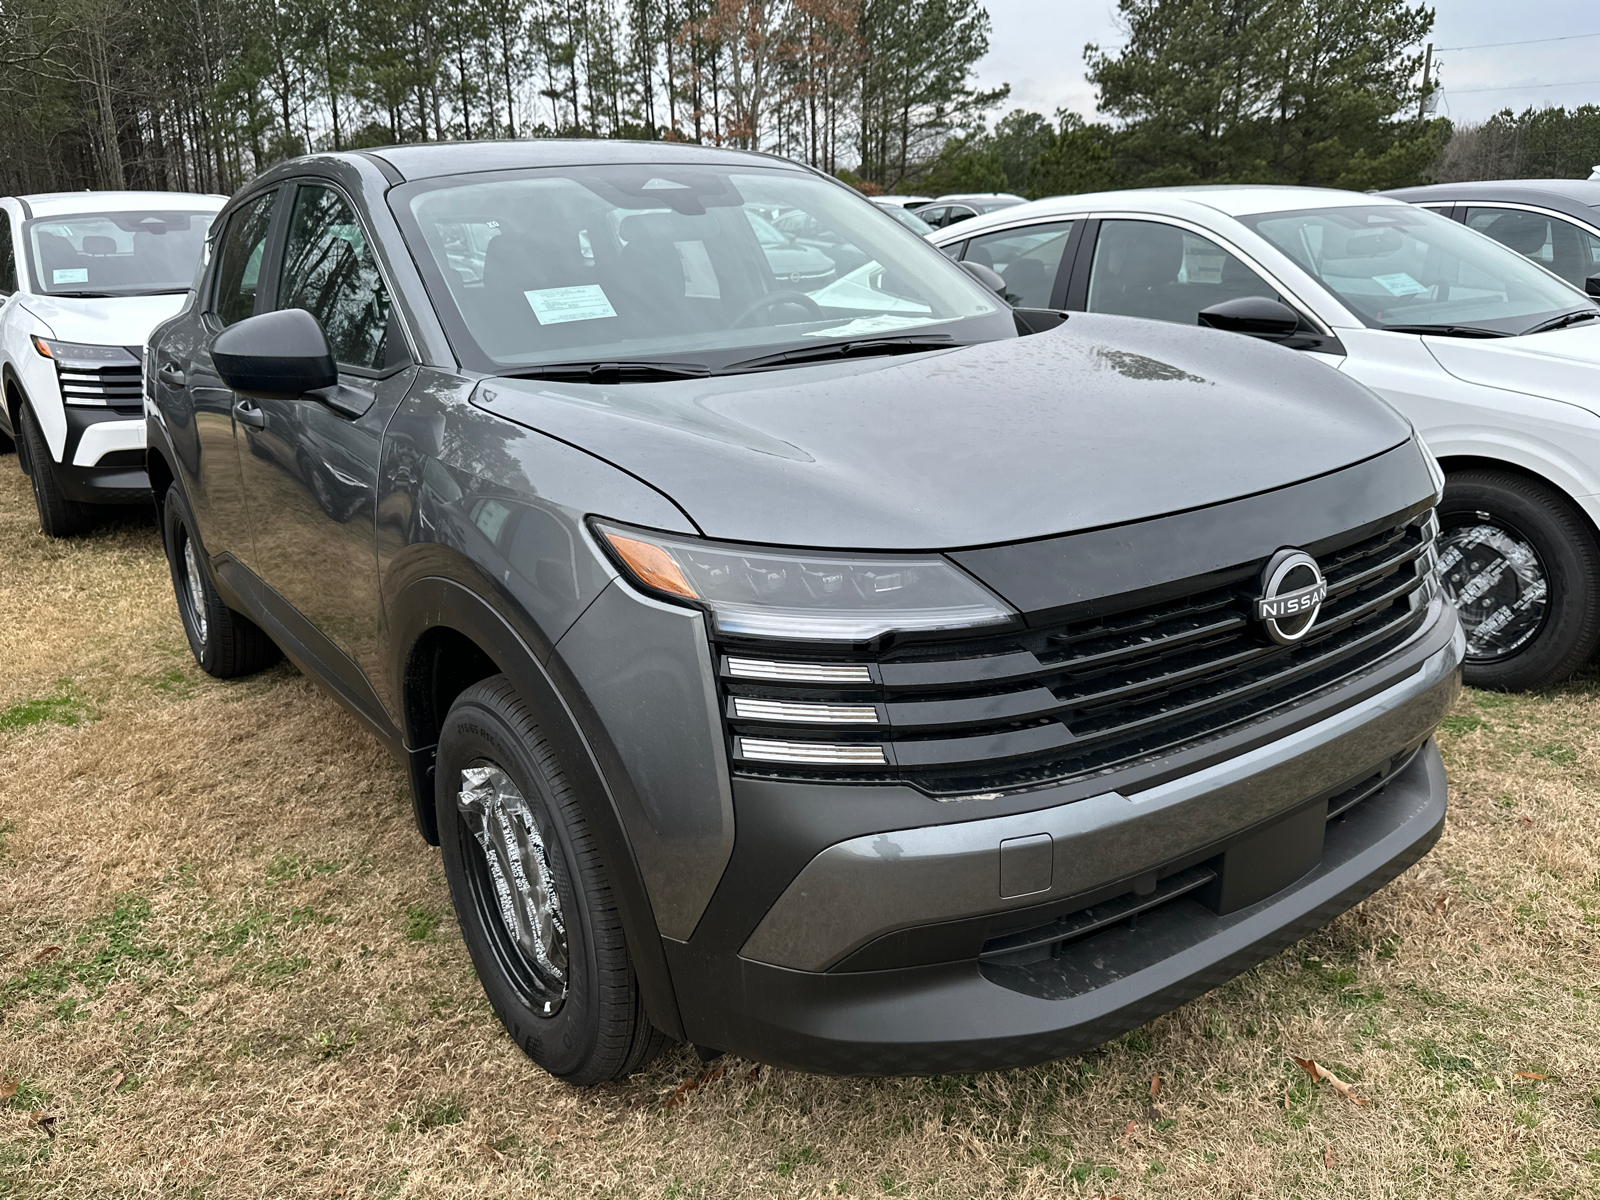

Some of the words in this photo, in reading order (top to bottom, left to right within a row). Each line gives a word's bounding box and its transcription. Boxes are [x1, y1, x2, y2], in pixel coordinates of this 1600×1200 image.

[1263, 585, 1327, 617] NISSAN
[480, 728, 495, 746] R16
[503, 828, 520, 861] REMOVE
[552, 917, 566, 935] MASK
